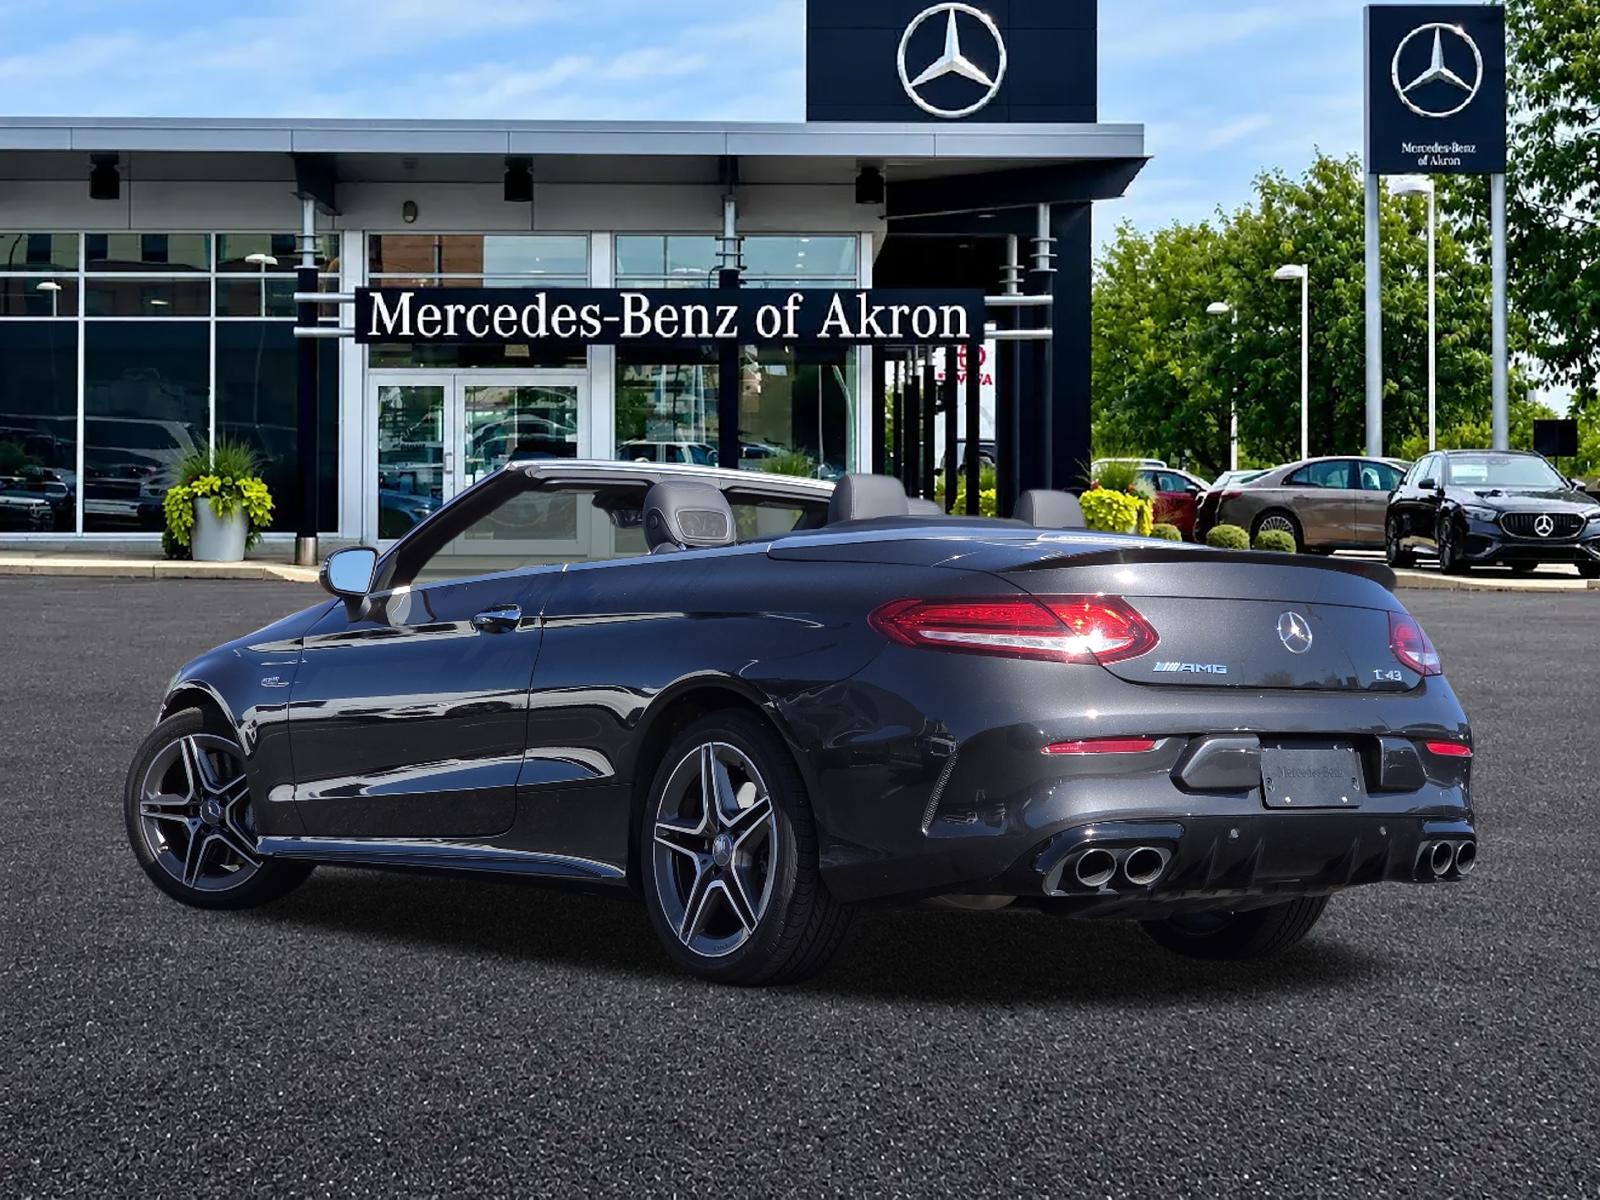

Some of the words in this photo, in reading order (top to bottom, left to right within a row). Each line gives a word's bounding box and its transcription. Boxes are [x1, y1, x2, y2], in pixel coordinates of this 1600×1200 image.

[1401, 142, 1477, 154] Mercedes-Benz
[1417, 155, 1428, 166] of
[1430, 155, 1461, 166] Akron
[367, 291, 738, 338] Mercedes-Benz
[755, 292, 804, 338] of
[816, 292, 971, 338] Akron
